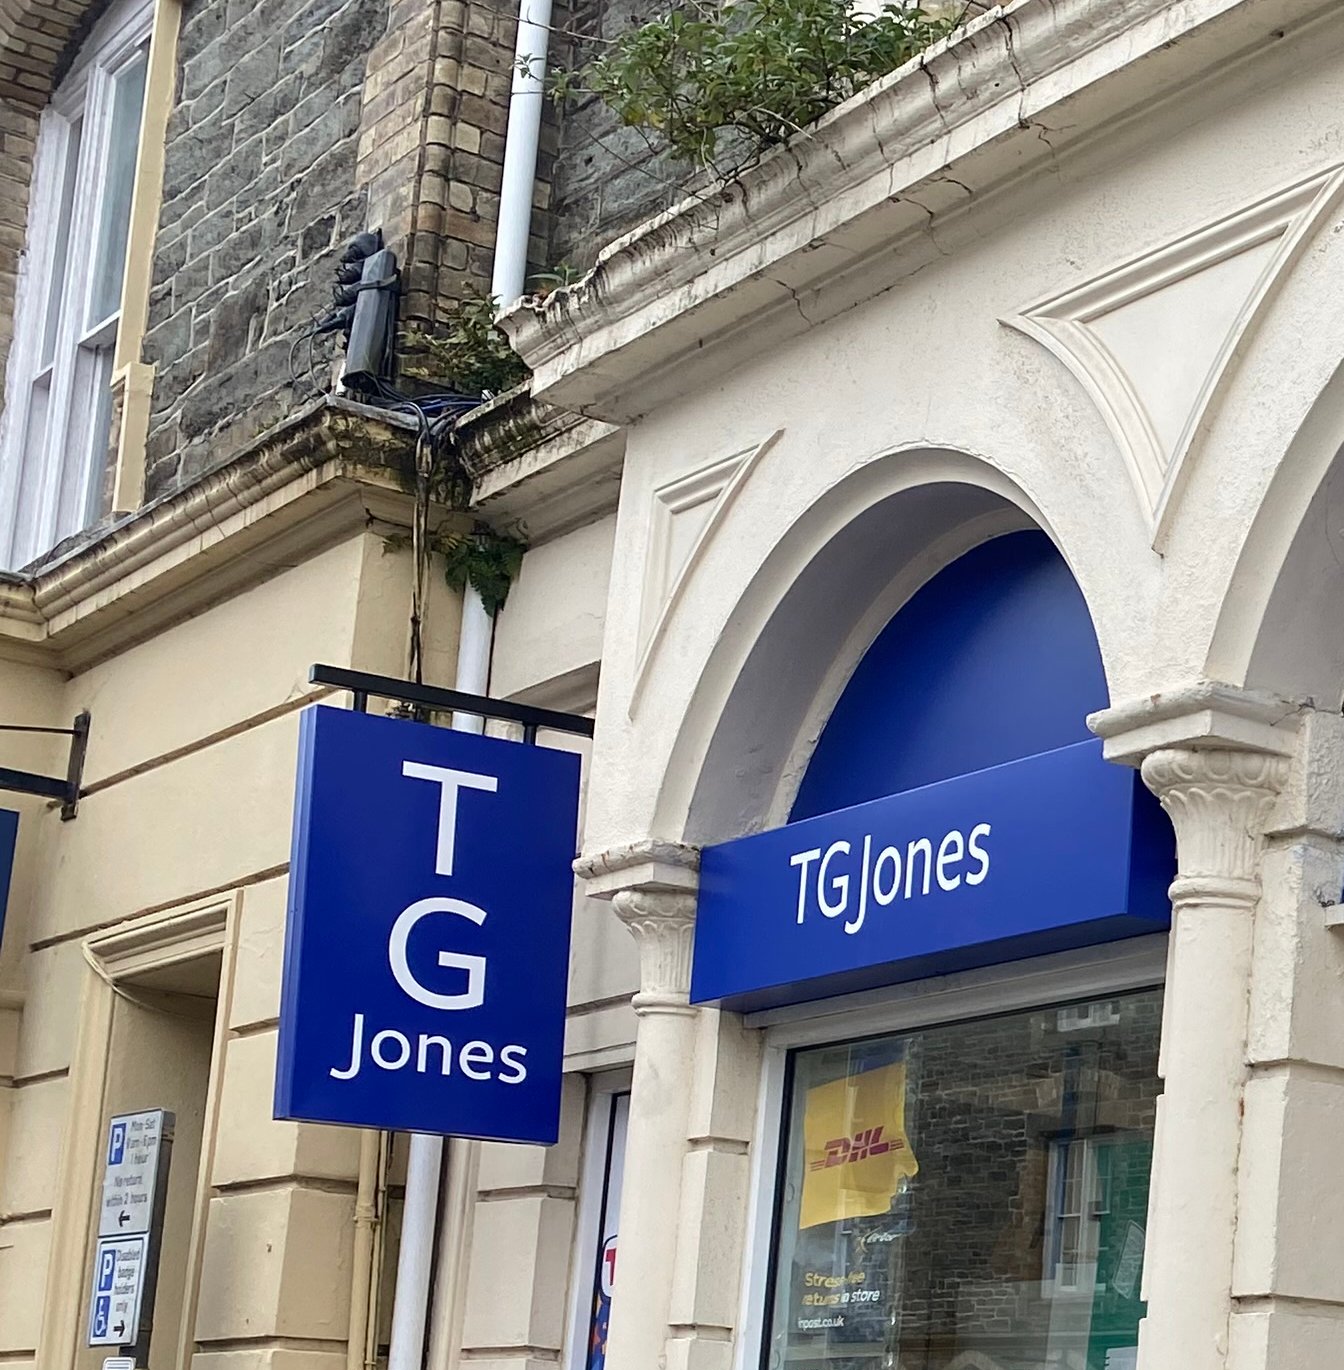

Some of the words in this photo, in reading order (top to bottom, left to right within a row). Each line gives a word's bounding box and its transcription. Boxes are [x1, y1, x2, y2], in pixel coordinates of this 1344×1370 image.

[402, 761, 498, 876] T
[388, 897, 488, 1010] G
[330, 1013, 528, 1085] Jones
[821, 1125, 892, 1169] DHL
[851, 1289, 881, 1302] store
